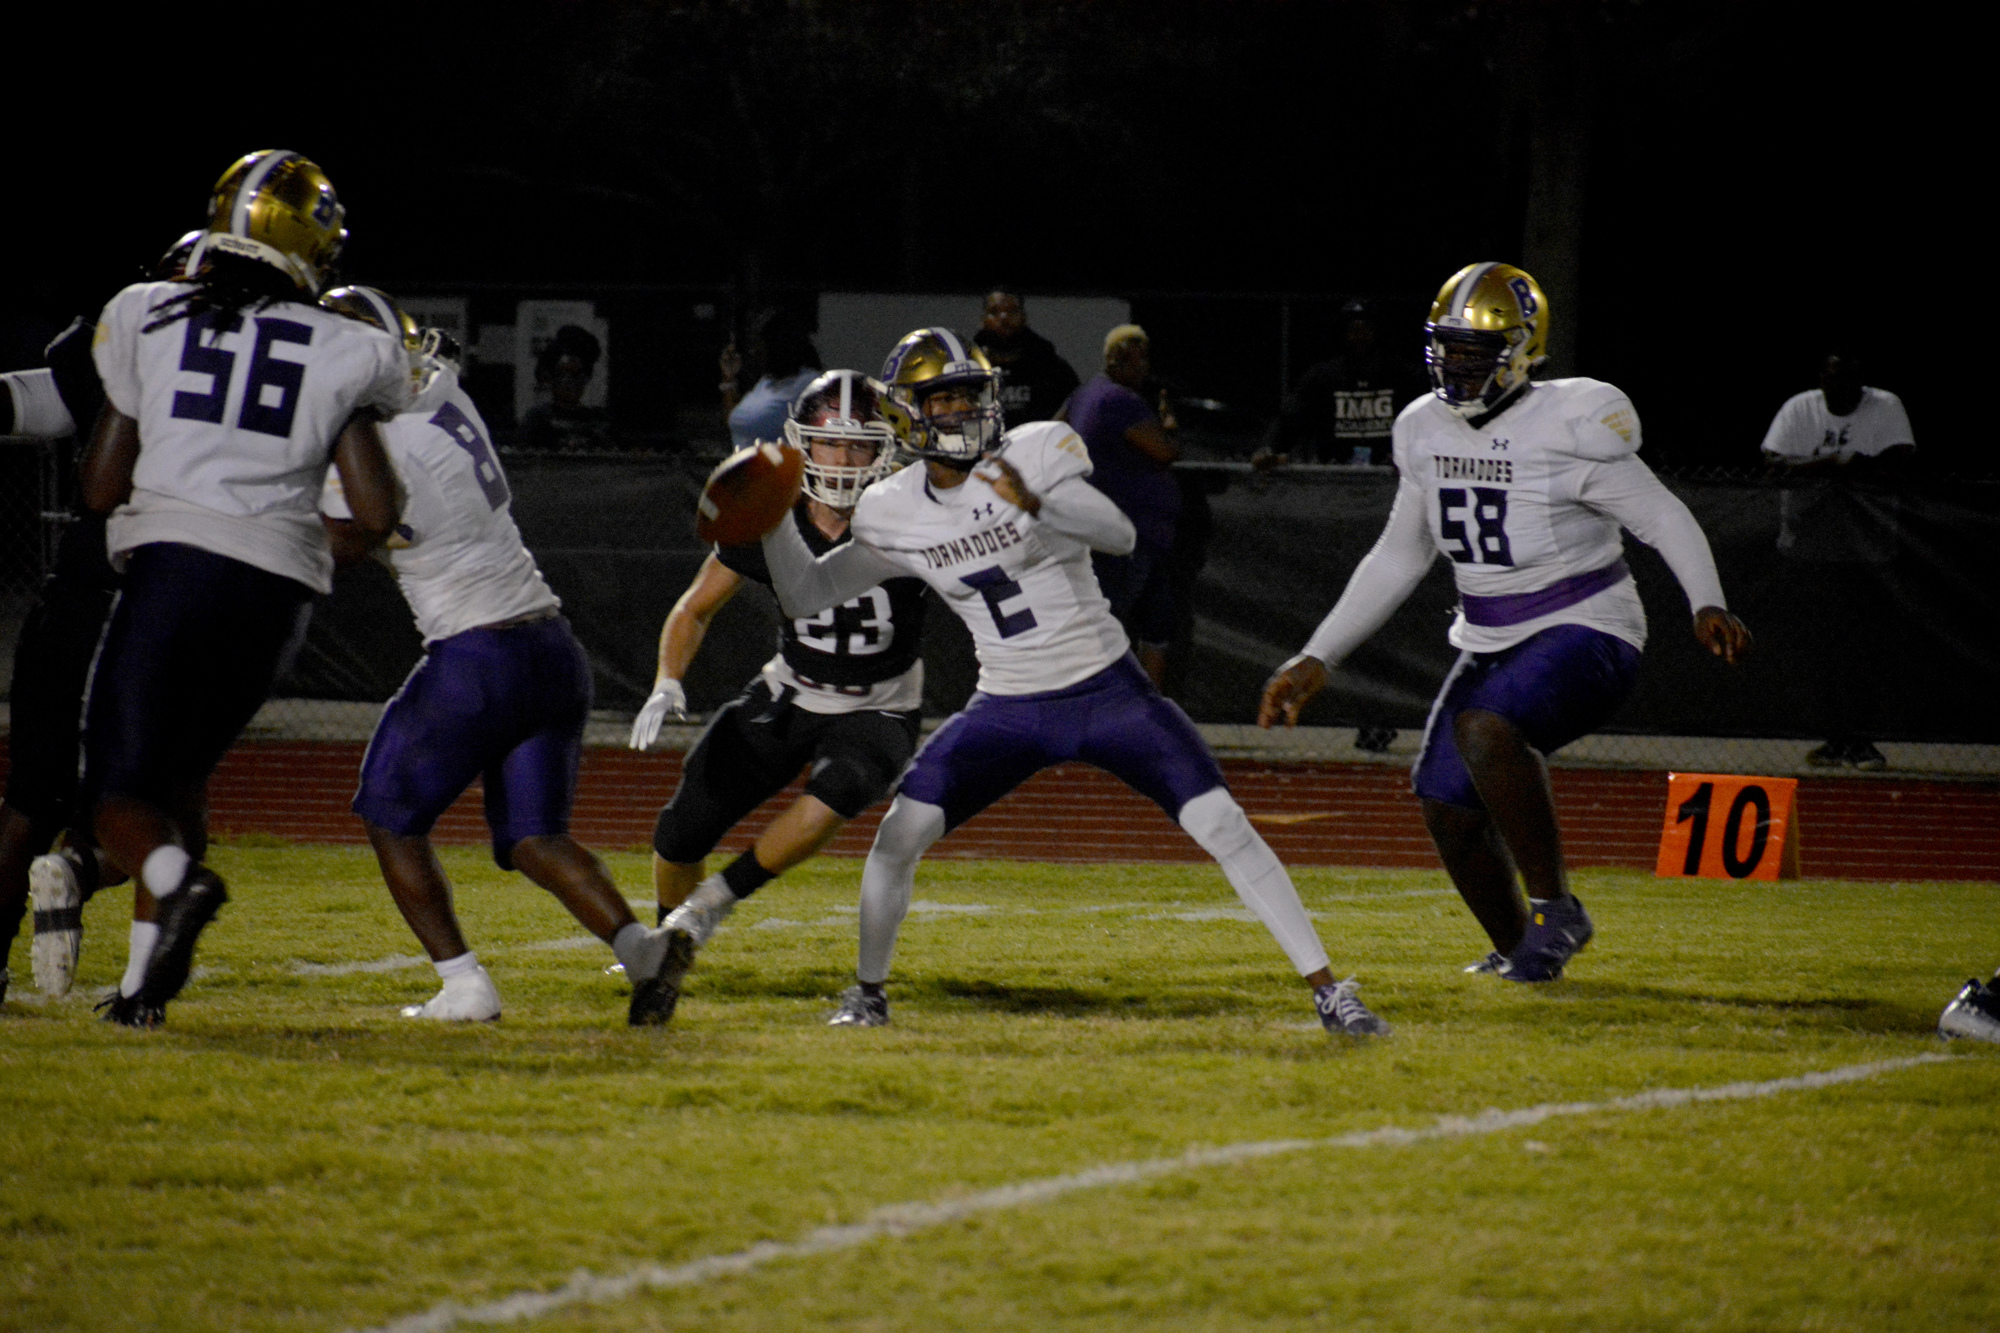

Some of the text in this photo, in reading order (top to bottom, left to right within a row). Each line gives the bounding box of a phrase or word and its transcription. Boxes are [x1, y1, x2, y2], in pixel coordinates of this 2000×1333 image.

[1508, 277, 1539, 320] B
[171, 312, 313, 438] 56
[1335, 396, 1394, 419] IMG
[428, 401, 510, 513] 8
[1434, 454, 1512, 484] TORNADOES
[921, 521, 1022, 569] TORNADOES
[1439, 486, 1514, 567] 58
[793, 585, 895, 656] 23
[958, 563, 1039, 640] 2
[1676, 782, 1770, 879] 10
